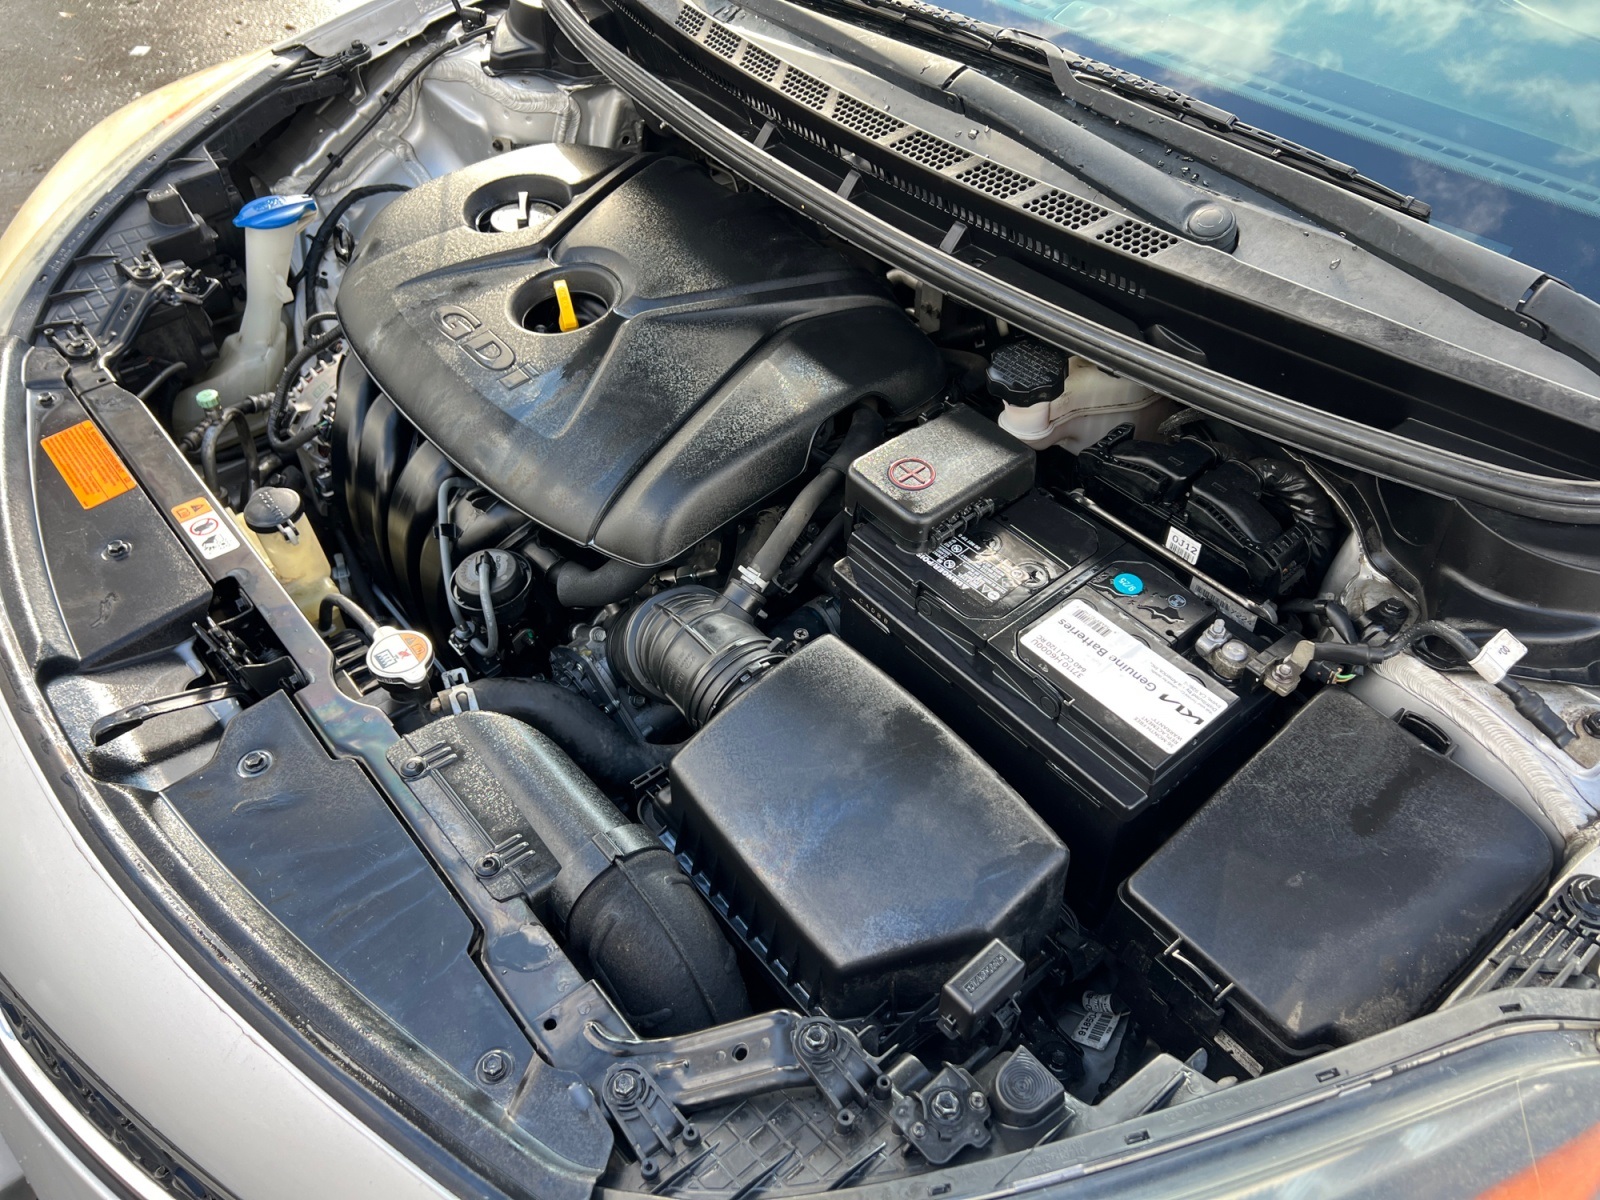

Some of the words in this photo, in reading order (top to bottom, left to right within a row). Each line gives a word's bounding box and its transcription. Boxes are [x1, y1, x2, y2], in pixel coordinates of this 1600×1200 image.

[1035, 634, 1047, 643] RC
[1044, 640, 1058, 651] 120
[1054, 617, 1109, 657] Batteries
[1058, 651, 1075, 663] CCA
[1060, 661, 1084, 678] 37110
[1072, 661, 1087, 672] 640
[1105, 654, 1159, 693] Genuine
[1157, 691, 1205, 726] KIA
[1132, 716, 1147, 727] FREE
[1140, 715, 1179, 744] REPLACEMENT
[1145, 725, 1167, 742] MONTH
